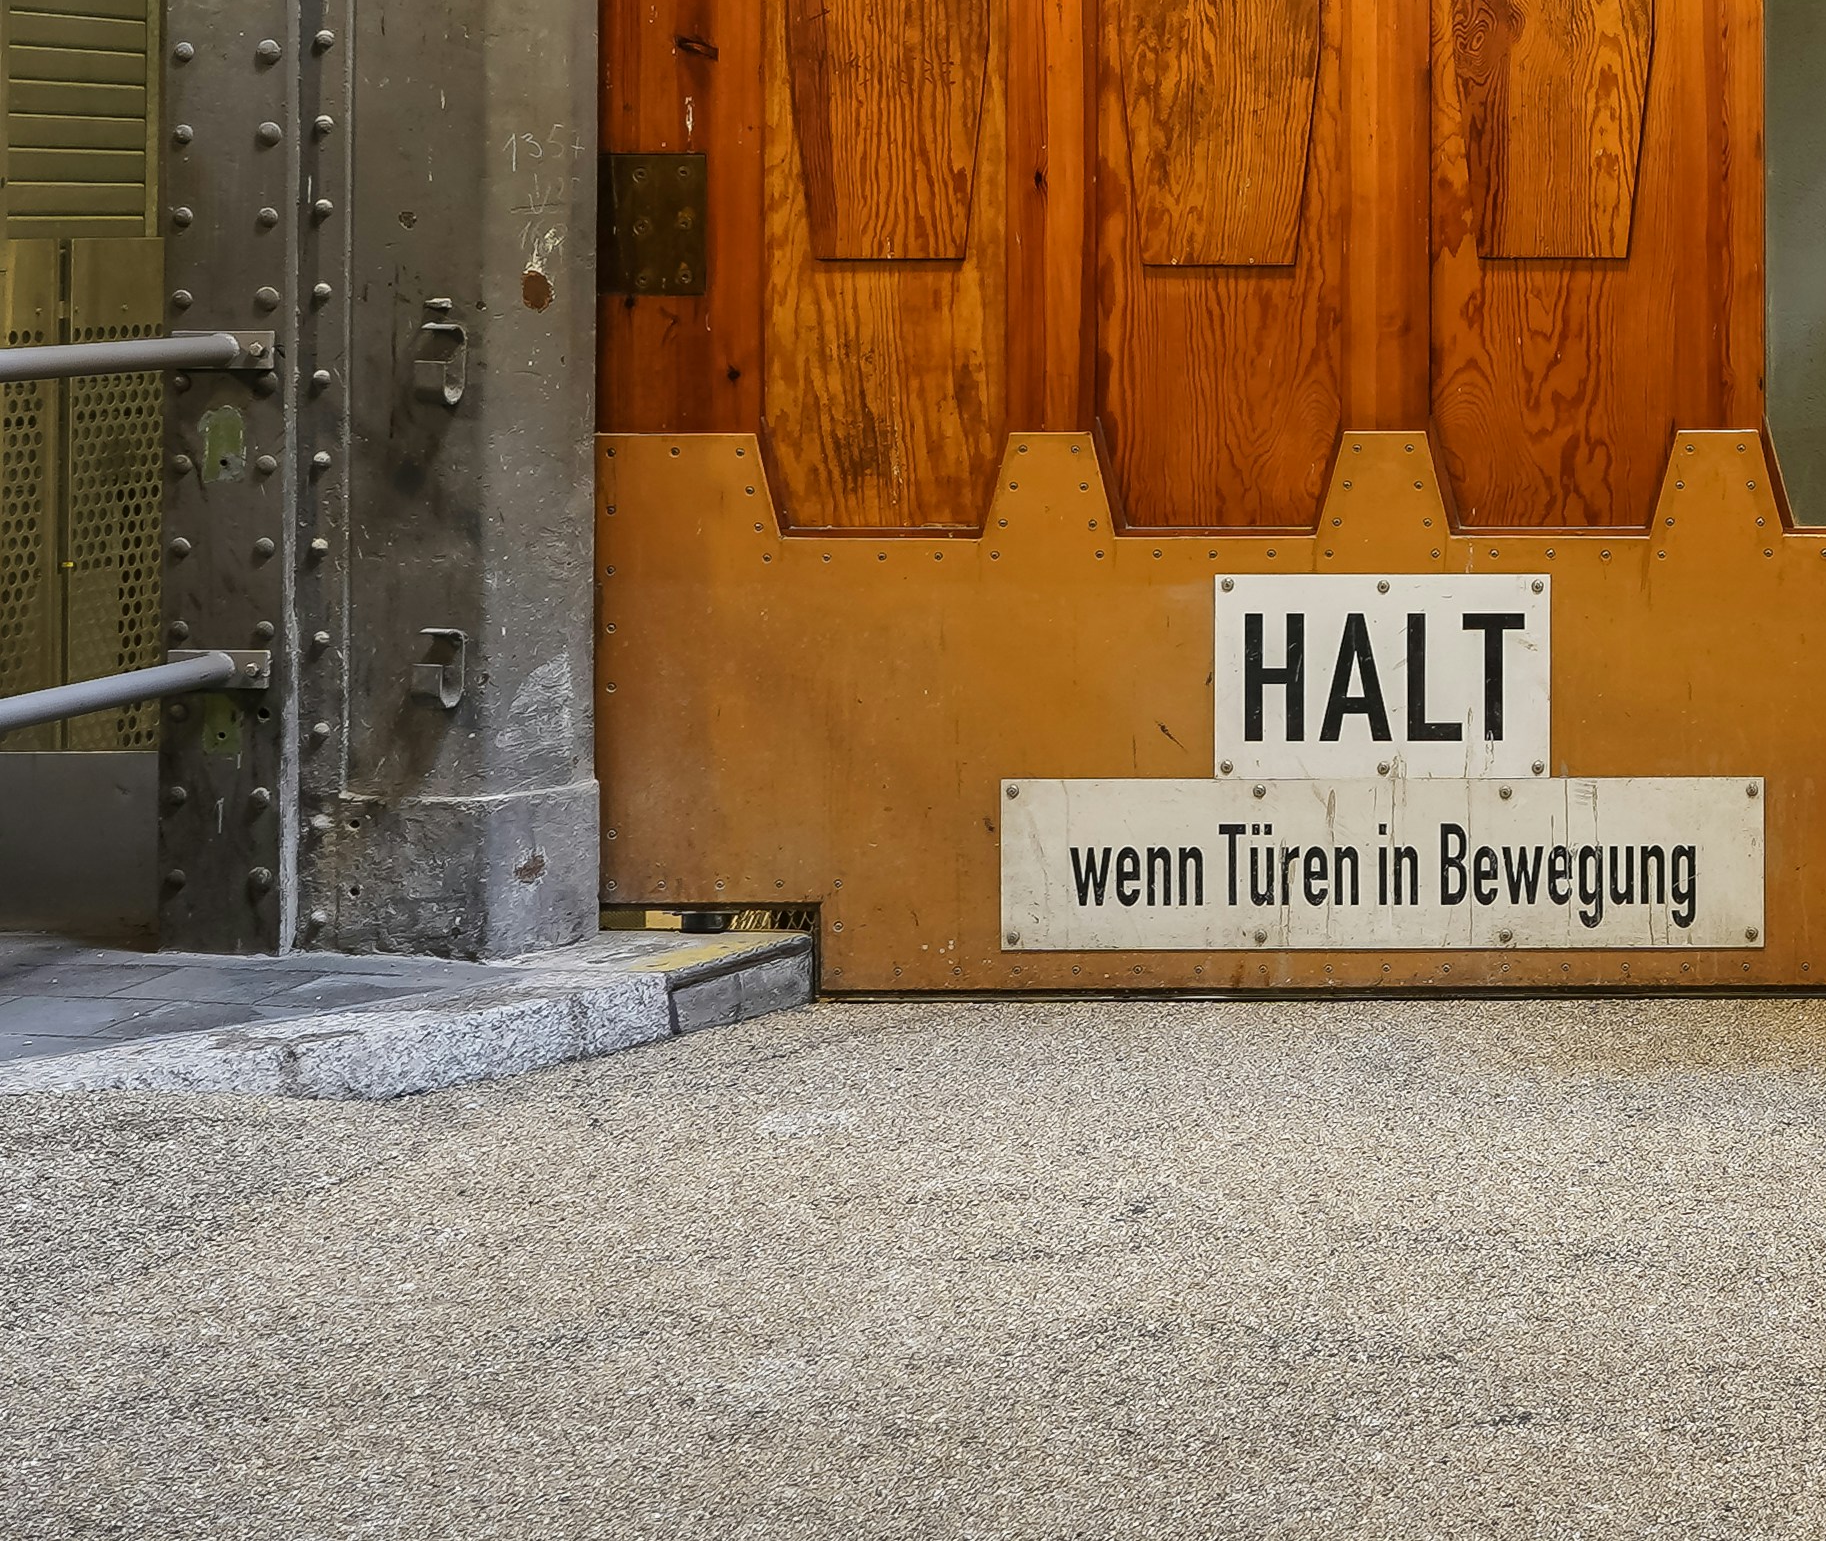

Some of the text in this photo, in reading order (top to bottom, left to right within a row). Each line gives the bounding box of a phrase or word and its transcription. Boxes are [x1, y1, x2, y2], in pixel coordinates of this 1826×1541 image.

[1244, 612, 1526, 743] HALT
[1070, 823, 1698, 928] wenn Türen in Bewegung
